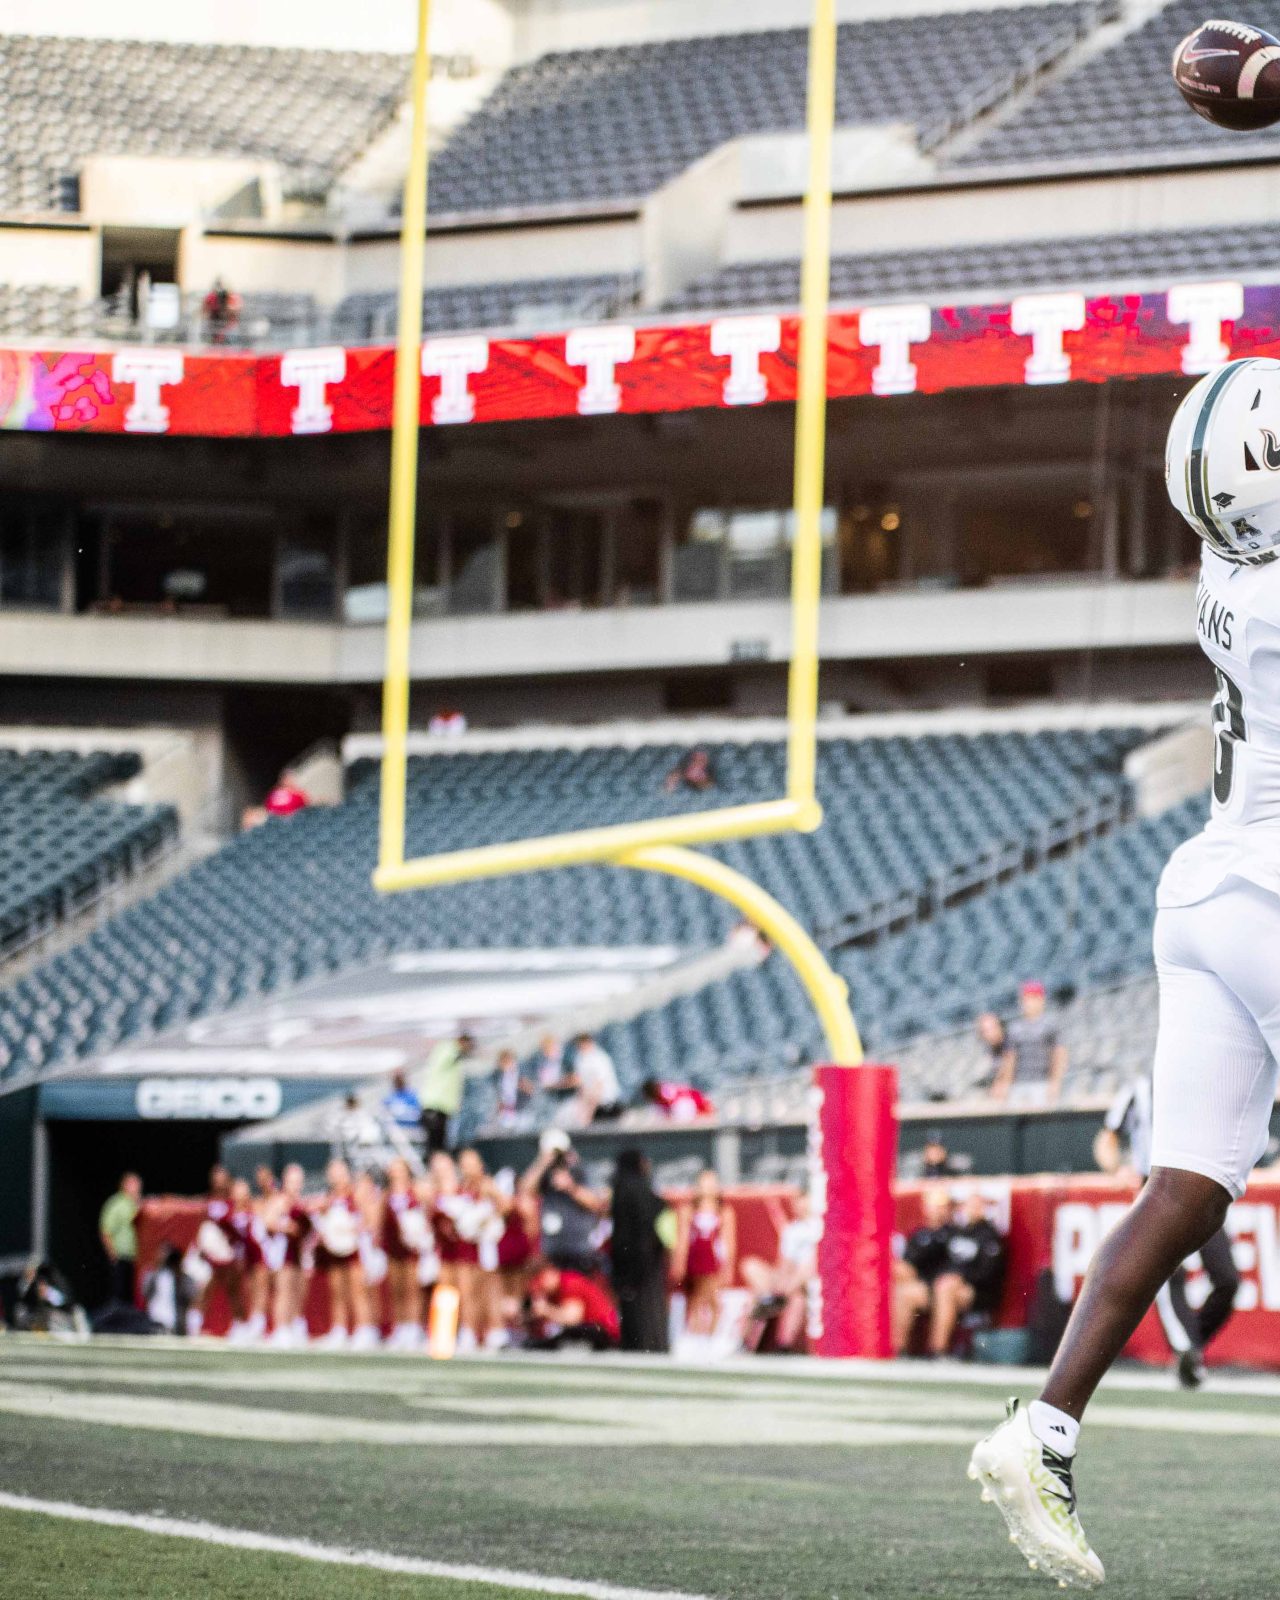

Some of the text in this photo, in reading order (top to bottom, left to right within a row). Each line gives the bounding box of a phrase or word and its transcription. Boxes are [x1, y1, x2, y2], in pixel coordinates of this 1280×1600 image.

[112, 348, 183, 433] T
[280, 347, 346, 434] T
[421, 336, 488, 424] T
[565, 325, 635, 415] T
[711, 315, 780, 405] T
[859, 304, 931, 395] T
[1011, 294, 1086, 385] T
[1167, 281, 1243, 376] T
[1197, 576, 1234, 651] VANS
